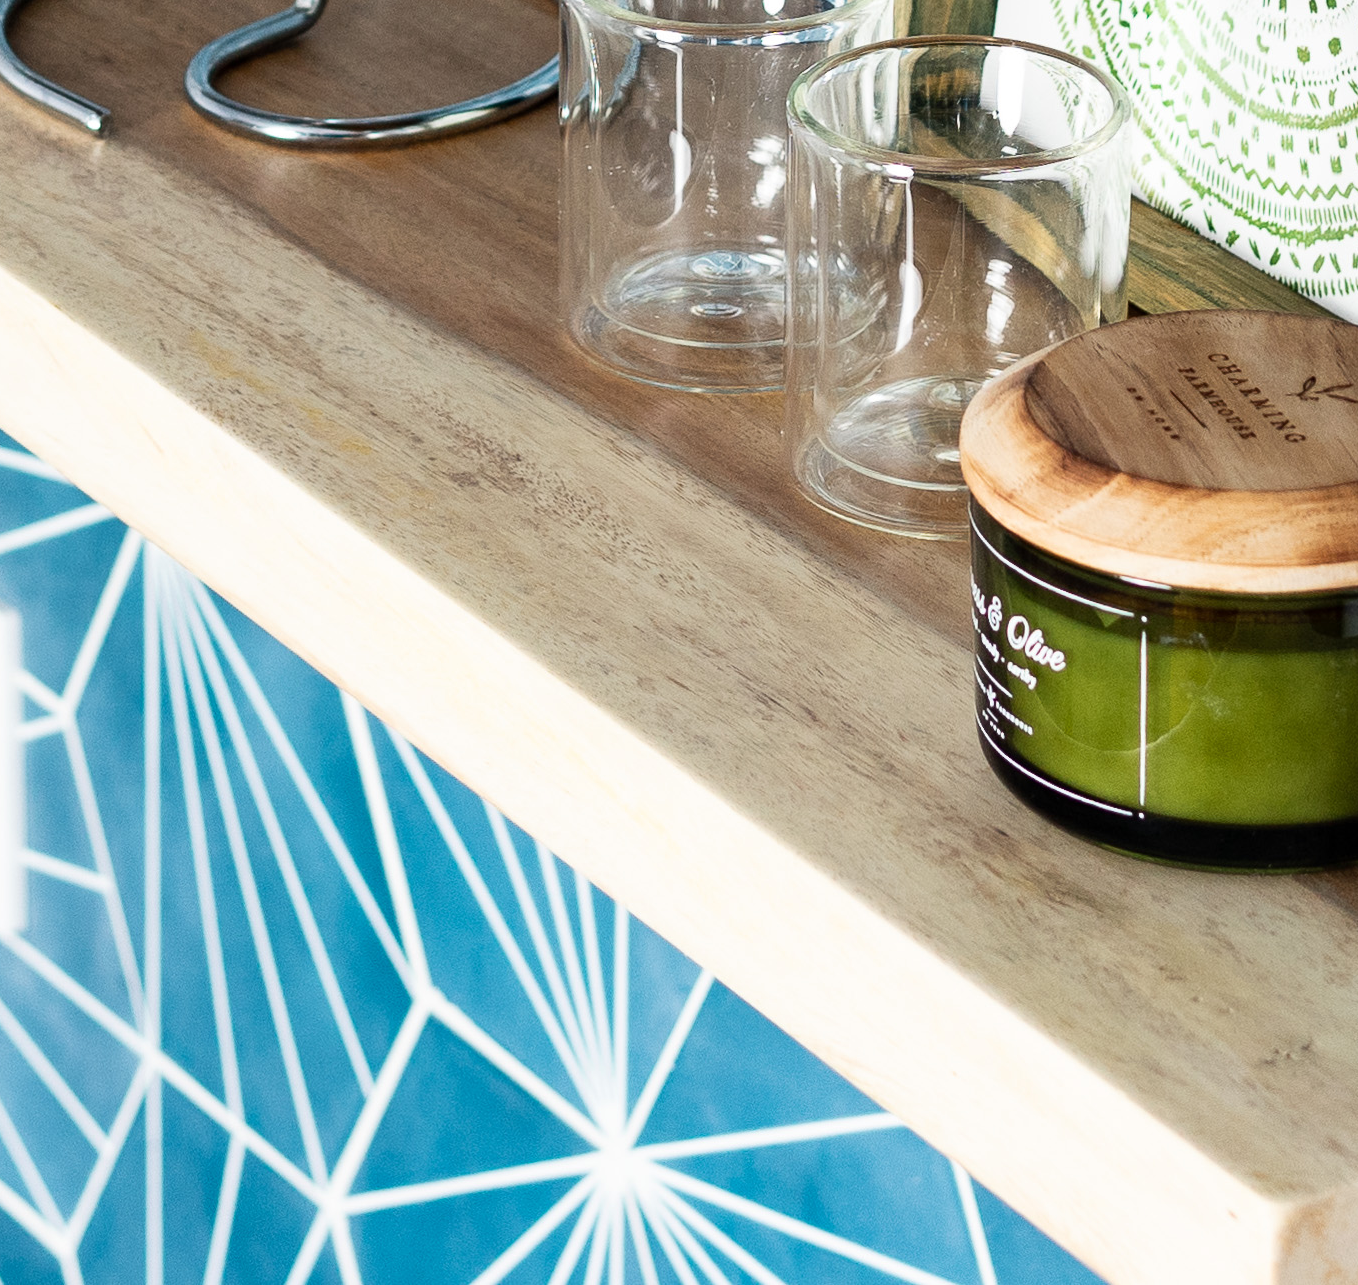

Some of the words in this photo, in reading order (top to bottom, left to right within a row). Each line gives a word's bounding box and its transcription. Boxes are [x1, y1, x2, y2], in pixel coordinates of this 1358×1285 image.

[1177, 366, 1258, 441] FARMHOUSE
[1208, 352, 1306, 444] CHARMING
[1007, 615, 1067, 672] Olive
